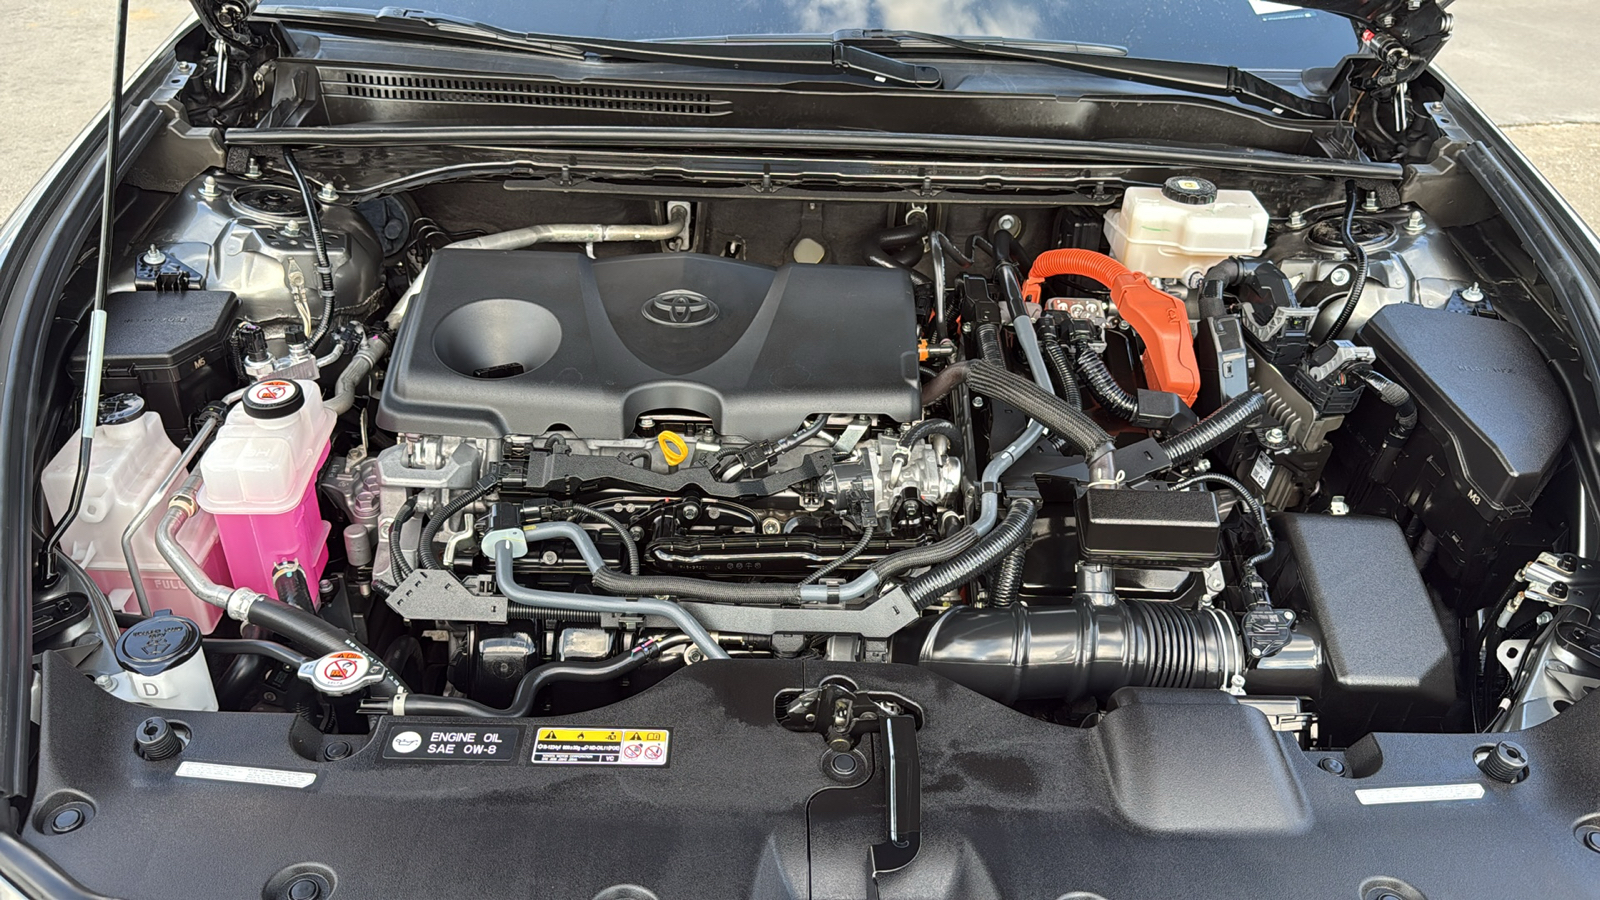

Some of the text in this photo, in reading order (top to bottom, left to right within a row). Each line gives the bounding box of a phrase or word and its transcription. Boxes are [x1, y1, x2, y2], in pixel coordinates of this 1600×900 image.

[1467, 489, 1481, 505] M3
[154, 579, 187, 590] FULL
[143, 683, 159, 696] D
[430, 732, 503, 743] ENGINE OIL
[427, 744, 456, 754] SAE
